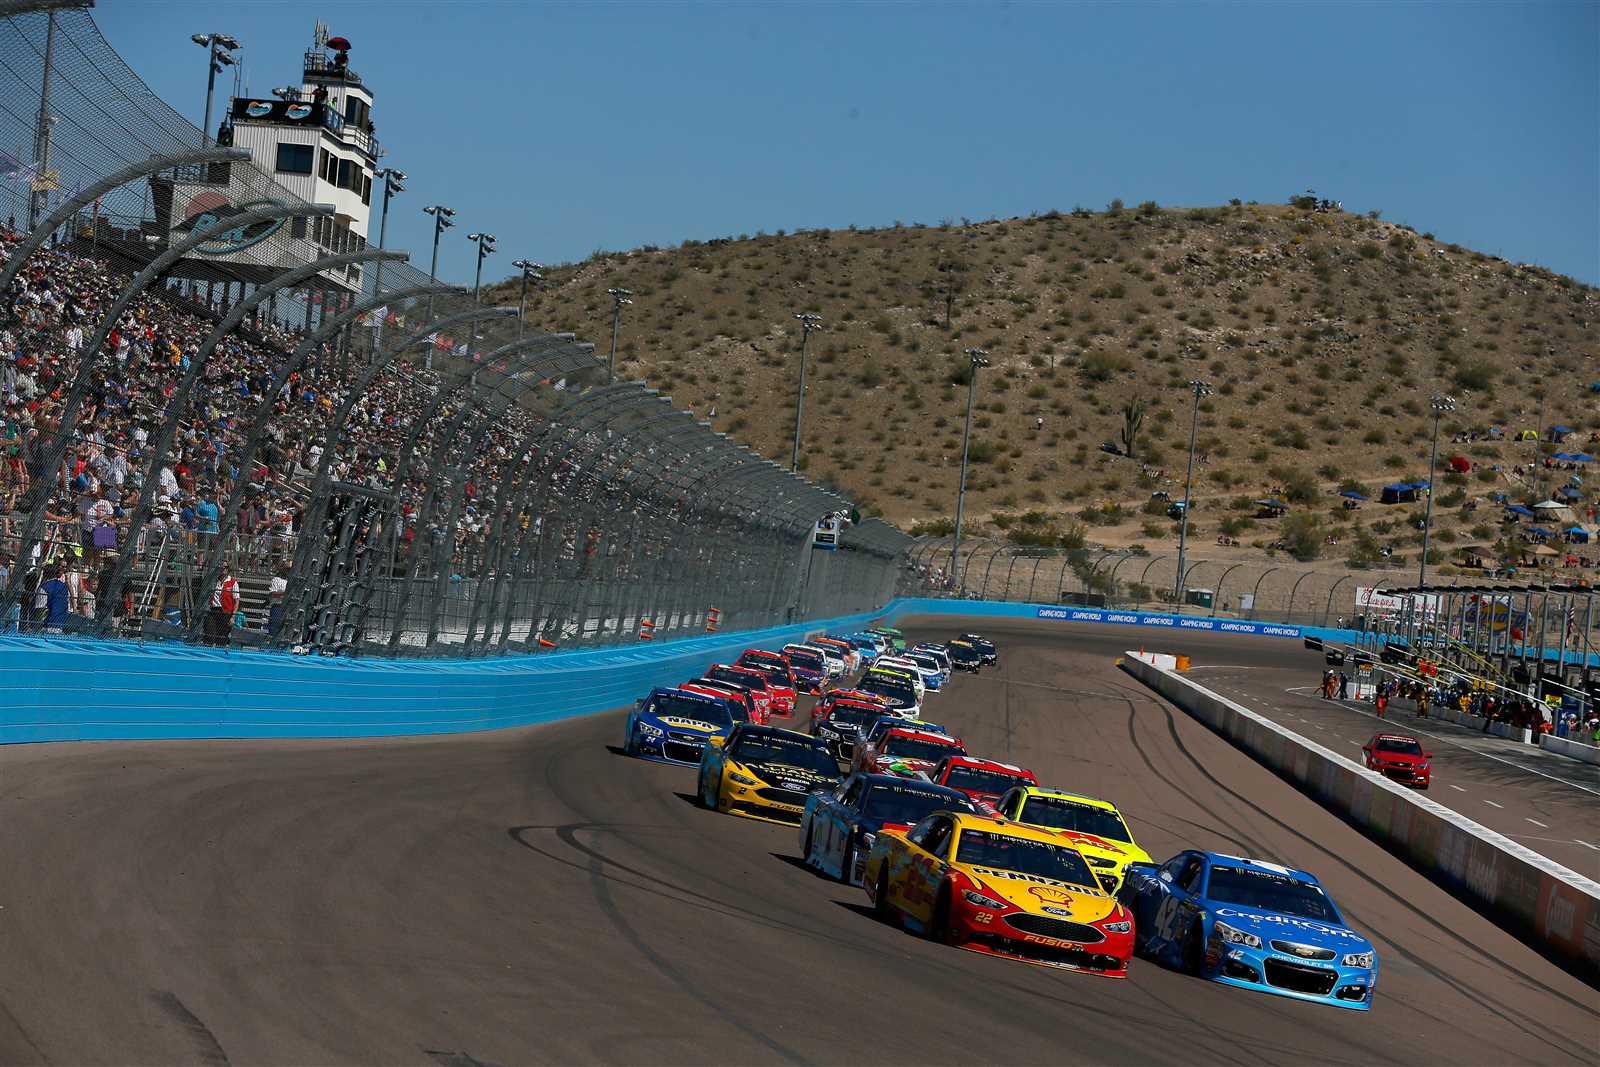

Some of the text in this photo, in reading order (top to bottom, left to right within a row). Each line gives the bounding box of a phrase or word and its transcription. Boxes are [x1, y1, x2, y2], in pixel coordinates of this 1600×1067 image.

[668, 717, 713, 729] NAPA
[737, 787, 747, 795] 2
[972, 867, 1102, 897] PENNZOIL
[974, 912, 994, 924] 22
[1227, 948, 1245, 961] 42
[1271, 953, 1321, 968] CHEVROLET
